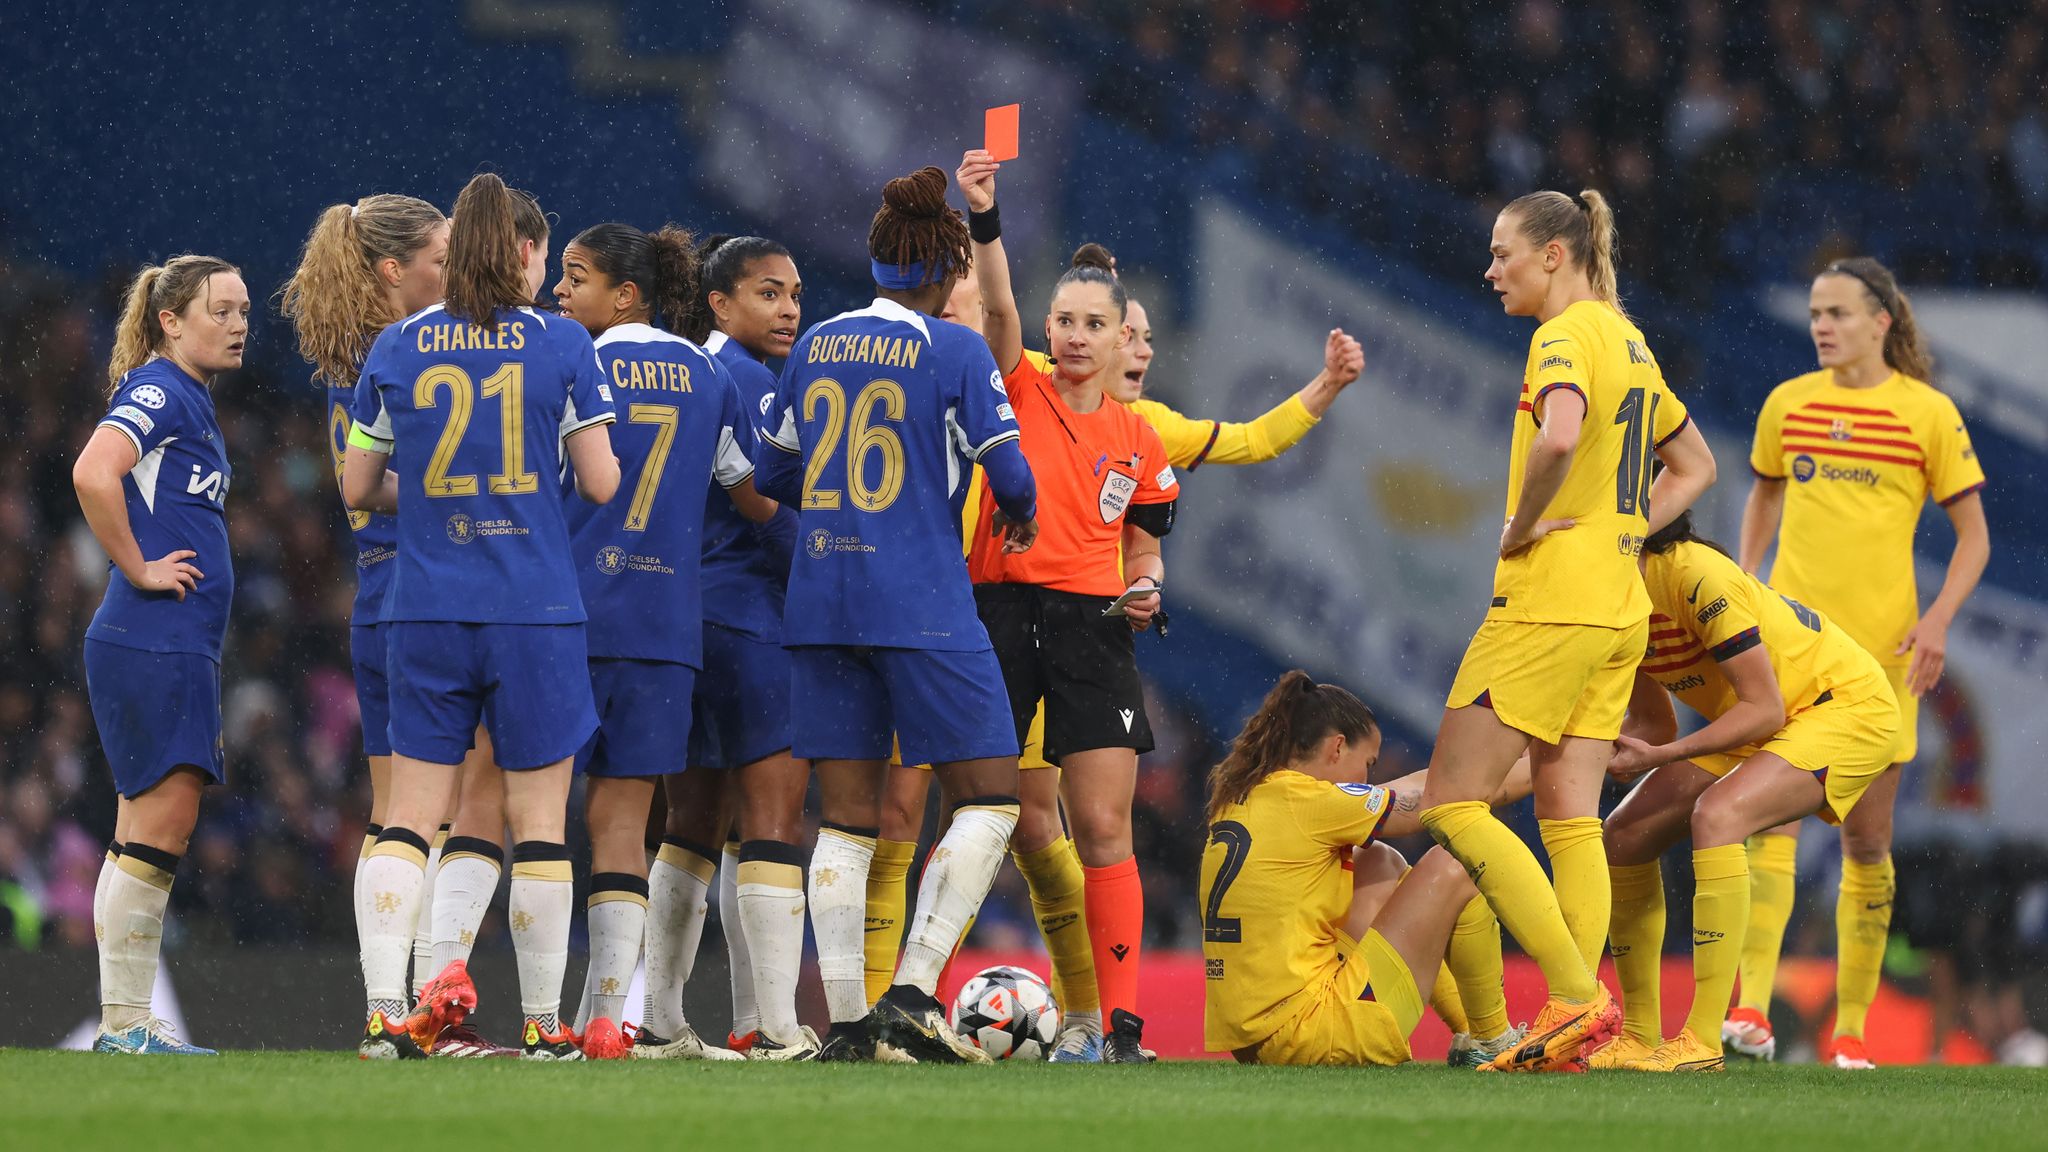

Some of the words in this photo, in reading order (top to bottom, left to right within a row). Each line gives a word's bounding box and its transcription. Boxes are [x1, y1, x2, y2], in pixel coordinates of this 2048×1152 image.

[417, 321, 525, 353] CHARLES
[808, 334, 921, 369] BUCHANAN
[612, 358, 693, 393] CARTER
[413, 362, 539, 498] 21
[801, 377, 906, 513] 26
[623, 403, 679, 532] 7
[1820, 464, 1880, 487] Spotify
[1111, 479, 1131, 494] UEFA
[1102, 498, 1123, 512] OFFICIAL
[1107, 492, 1125, 505] MATCH
[476, 519, 513, 529] CHELSEA
[476, 527, 529, 536] FOUNDATION
[361, 546, 386, 558] HELSEA
[362, 550, 398, 566] OUNDATION
[628, 554, 661, 565] CHELSEA
[627, 562, 675, 575] FOUNDATION
[864, 917, 894, 926] arça
[1206, 958, 1224, 968] NHCR
